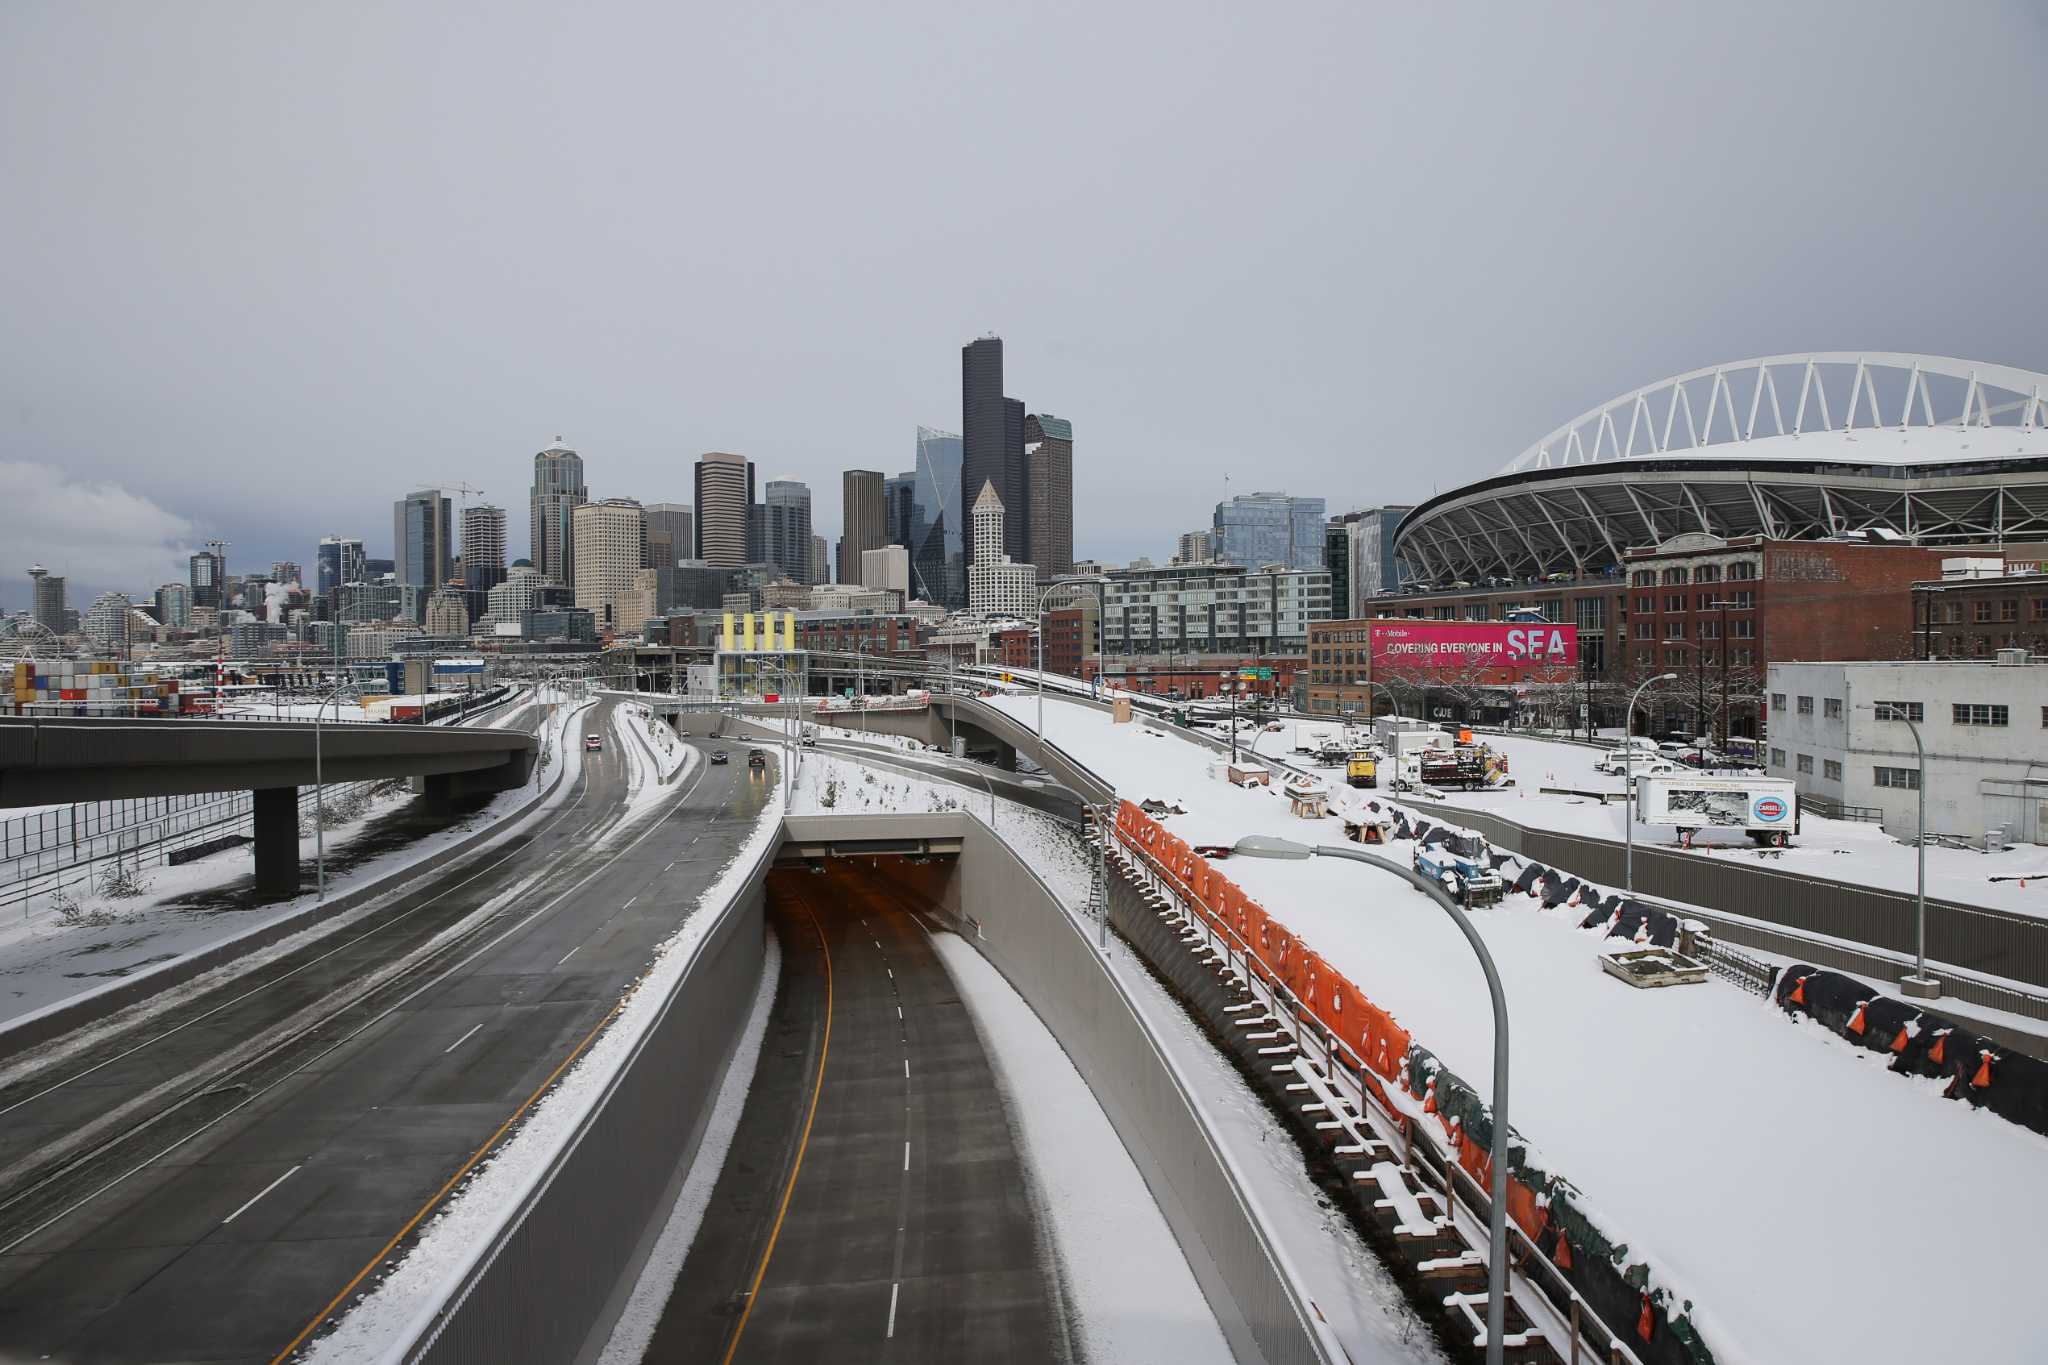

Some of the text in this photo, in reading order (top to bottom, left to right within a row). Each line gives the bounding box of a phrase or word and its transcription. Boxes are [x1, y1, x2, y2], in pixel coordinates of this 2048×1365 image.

[1387, 642, 1438, 655] COVERING
[1440, 642, 1490, 654] EVERYONE
[1492, 642, 1502, 654] IN
[1507, 630, 1565, 660] SEA
